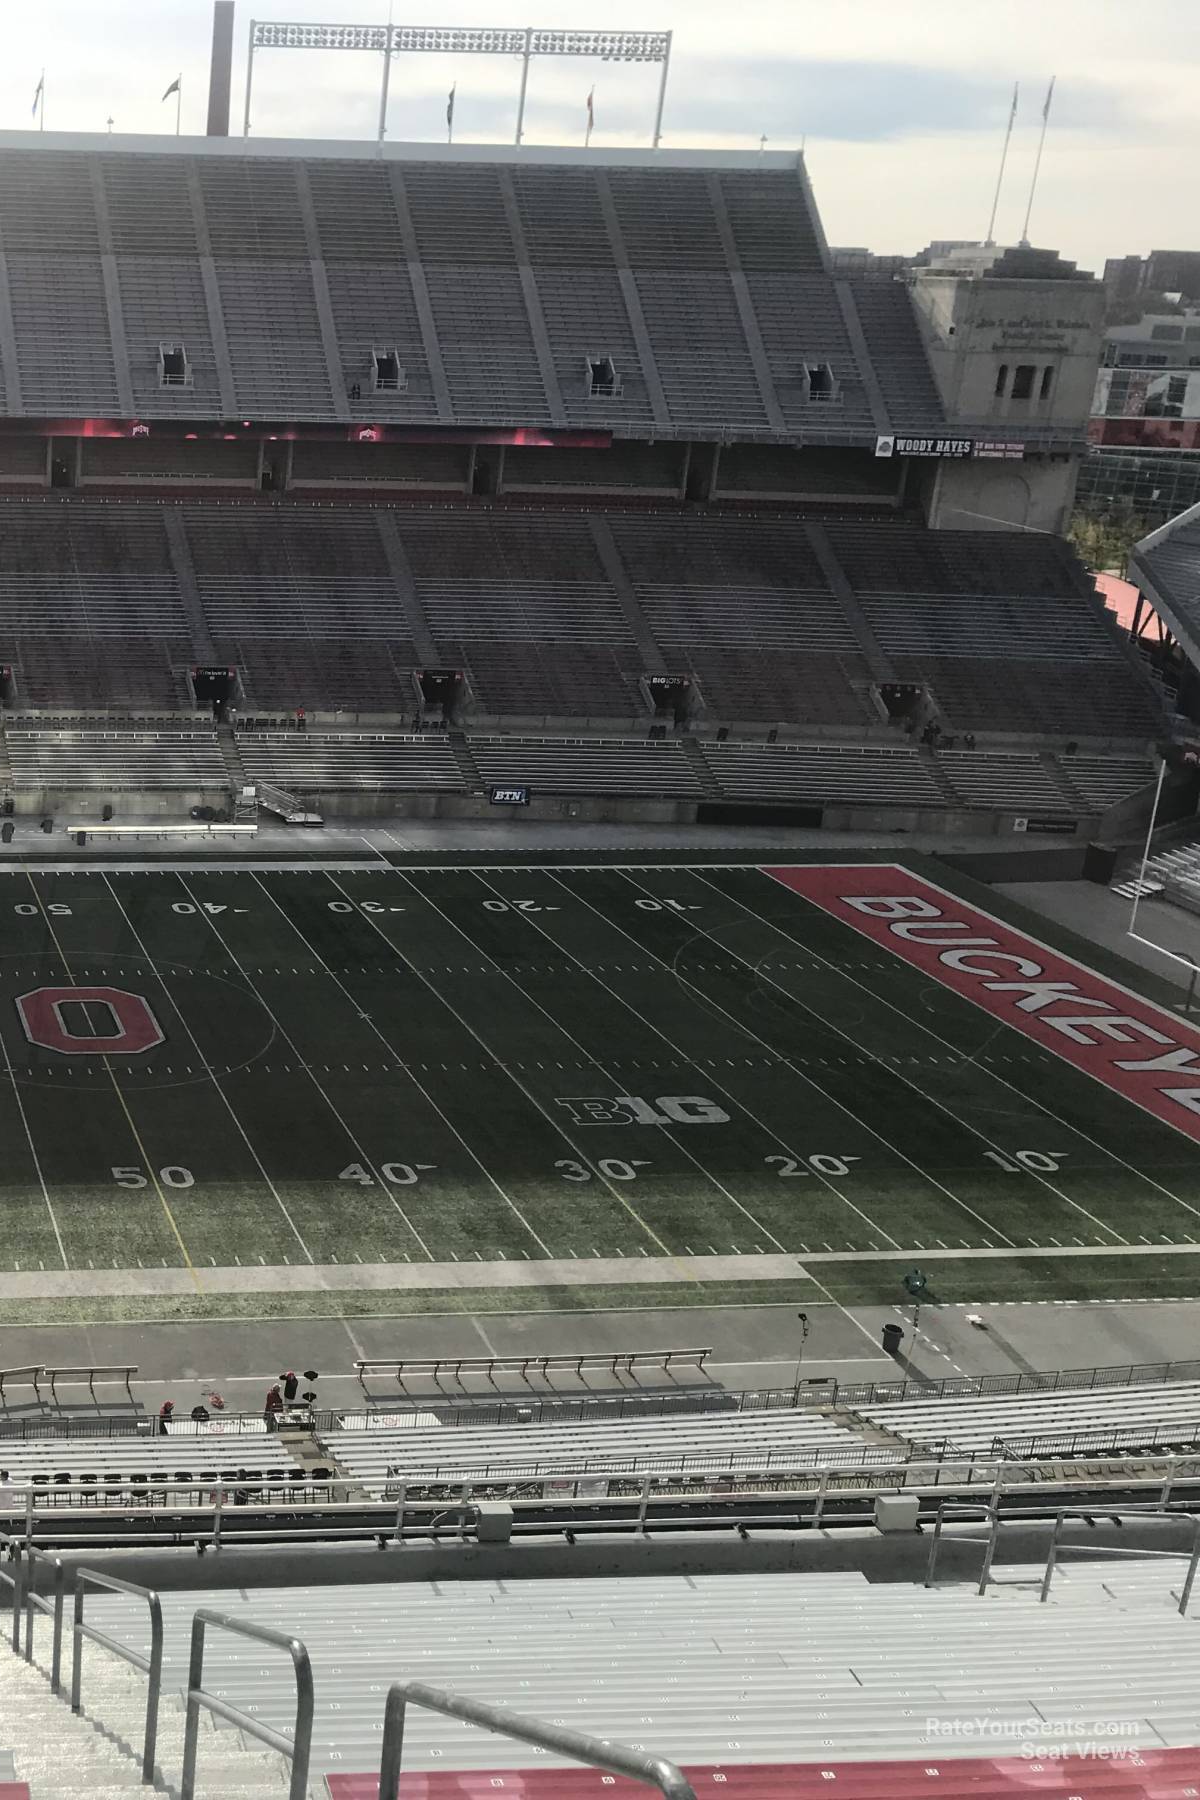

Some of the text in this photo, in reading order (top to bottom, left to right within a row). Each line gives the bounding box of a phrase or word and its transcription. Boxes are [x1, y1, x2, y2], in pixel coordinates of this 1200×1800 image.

[896, 439, 933, 451] WOODY
[936, 440, 971, 453] HAYES
[494, 791, 521, 801] BTN
[14, 903, 73, 916] 50
[171, 902, 228, 916] 40
[327, 901, 386, 914] 30
[483, 900, 542, 913] 20
[634, 899, 685, 911] 10
[764, 1155, 848, 1178] 20
[981, 1149, 1057, 1173] 10
[337, 1161, 419, 1187] 40
[554, 1158, 637, 1182] 30
[112, 1166, 196, 1190] 50
